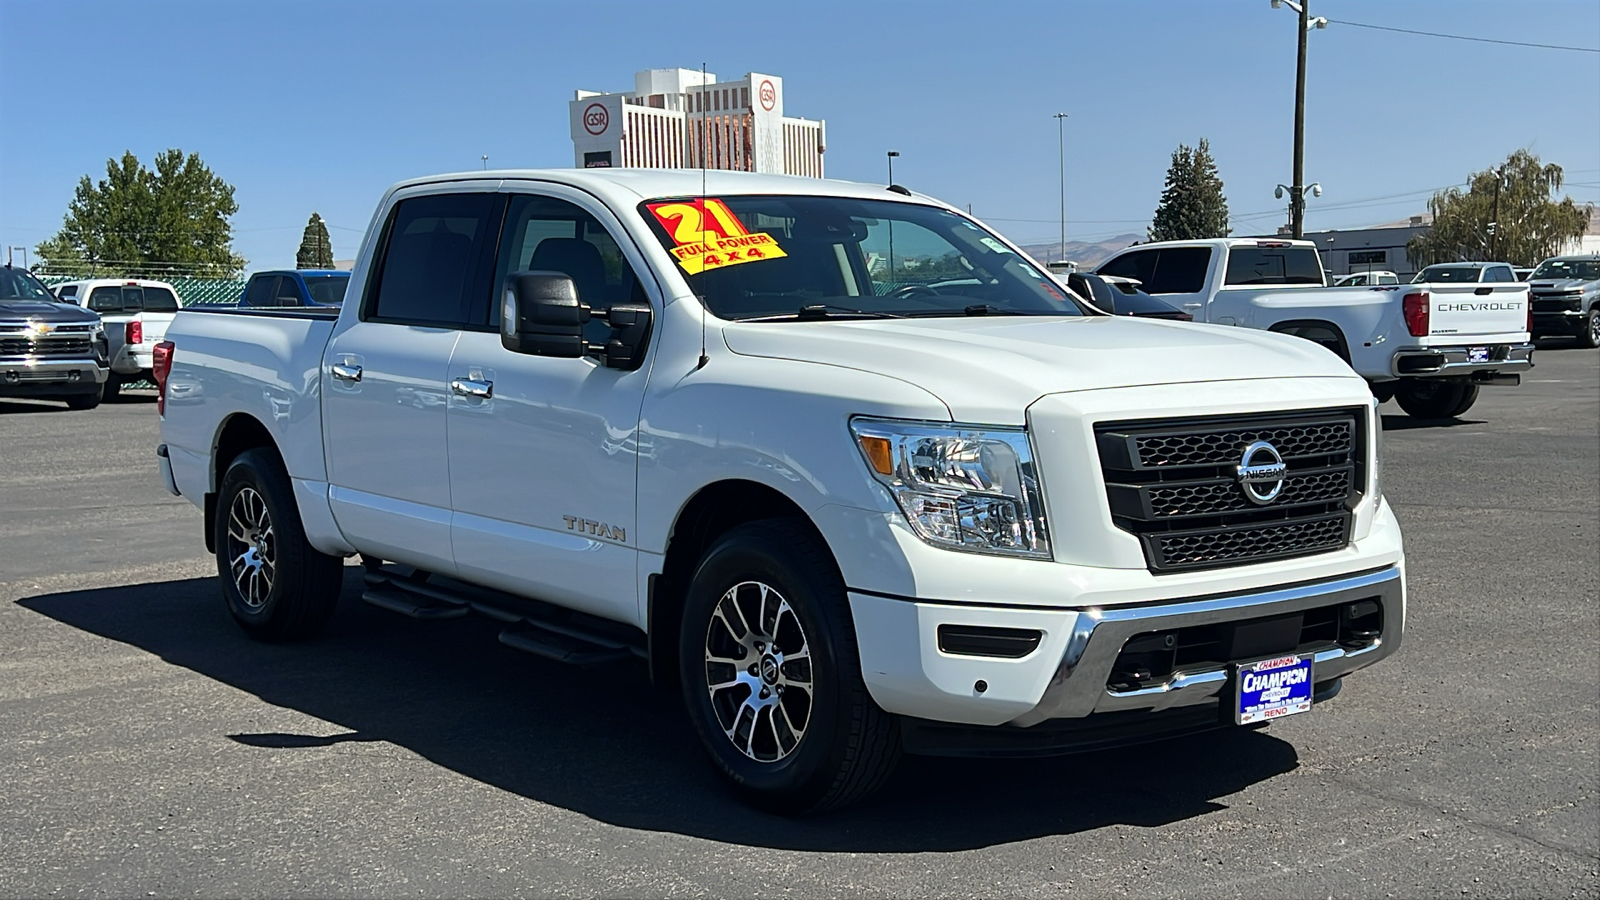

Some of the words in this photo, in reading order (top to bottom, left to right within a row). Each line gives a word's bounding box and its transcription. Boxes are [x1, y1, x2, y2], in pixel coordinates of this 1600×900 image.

[762, 89, 774, 102] GSR
[587, 112, 605, 126] GSR
[655, 199, 744, 243] 21
[675, 243, 715, 259] FULL
[717, 235, 772, 250] POWER
[1438, 302, 1523, 312] CHEVROLET
[1246, 467, 1284, 479] NISSAN
[562, 514, 626, 542] TITAN
[1259, 656, 1294, 671] CHAMPION
[1242, 667, 1308, 693] CHAMPION
[1262, 689, 1288, 699] CHEVROLET
[1264, 707, 1288, 718] RENO
